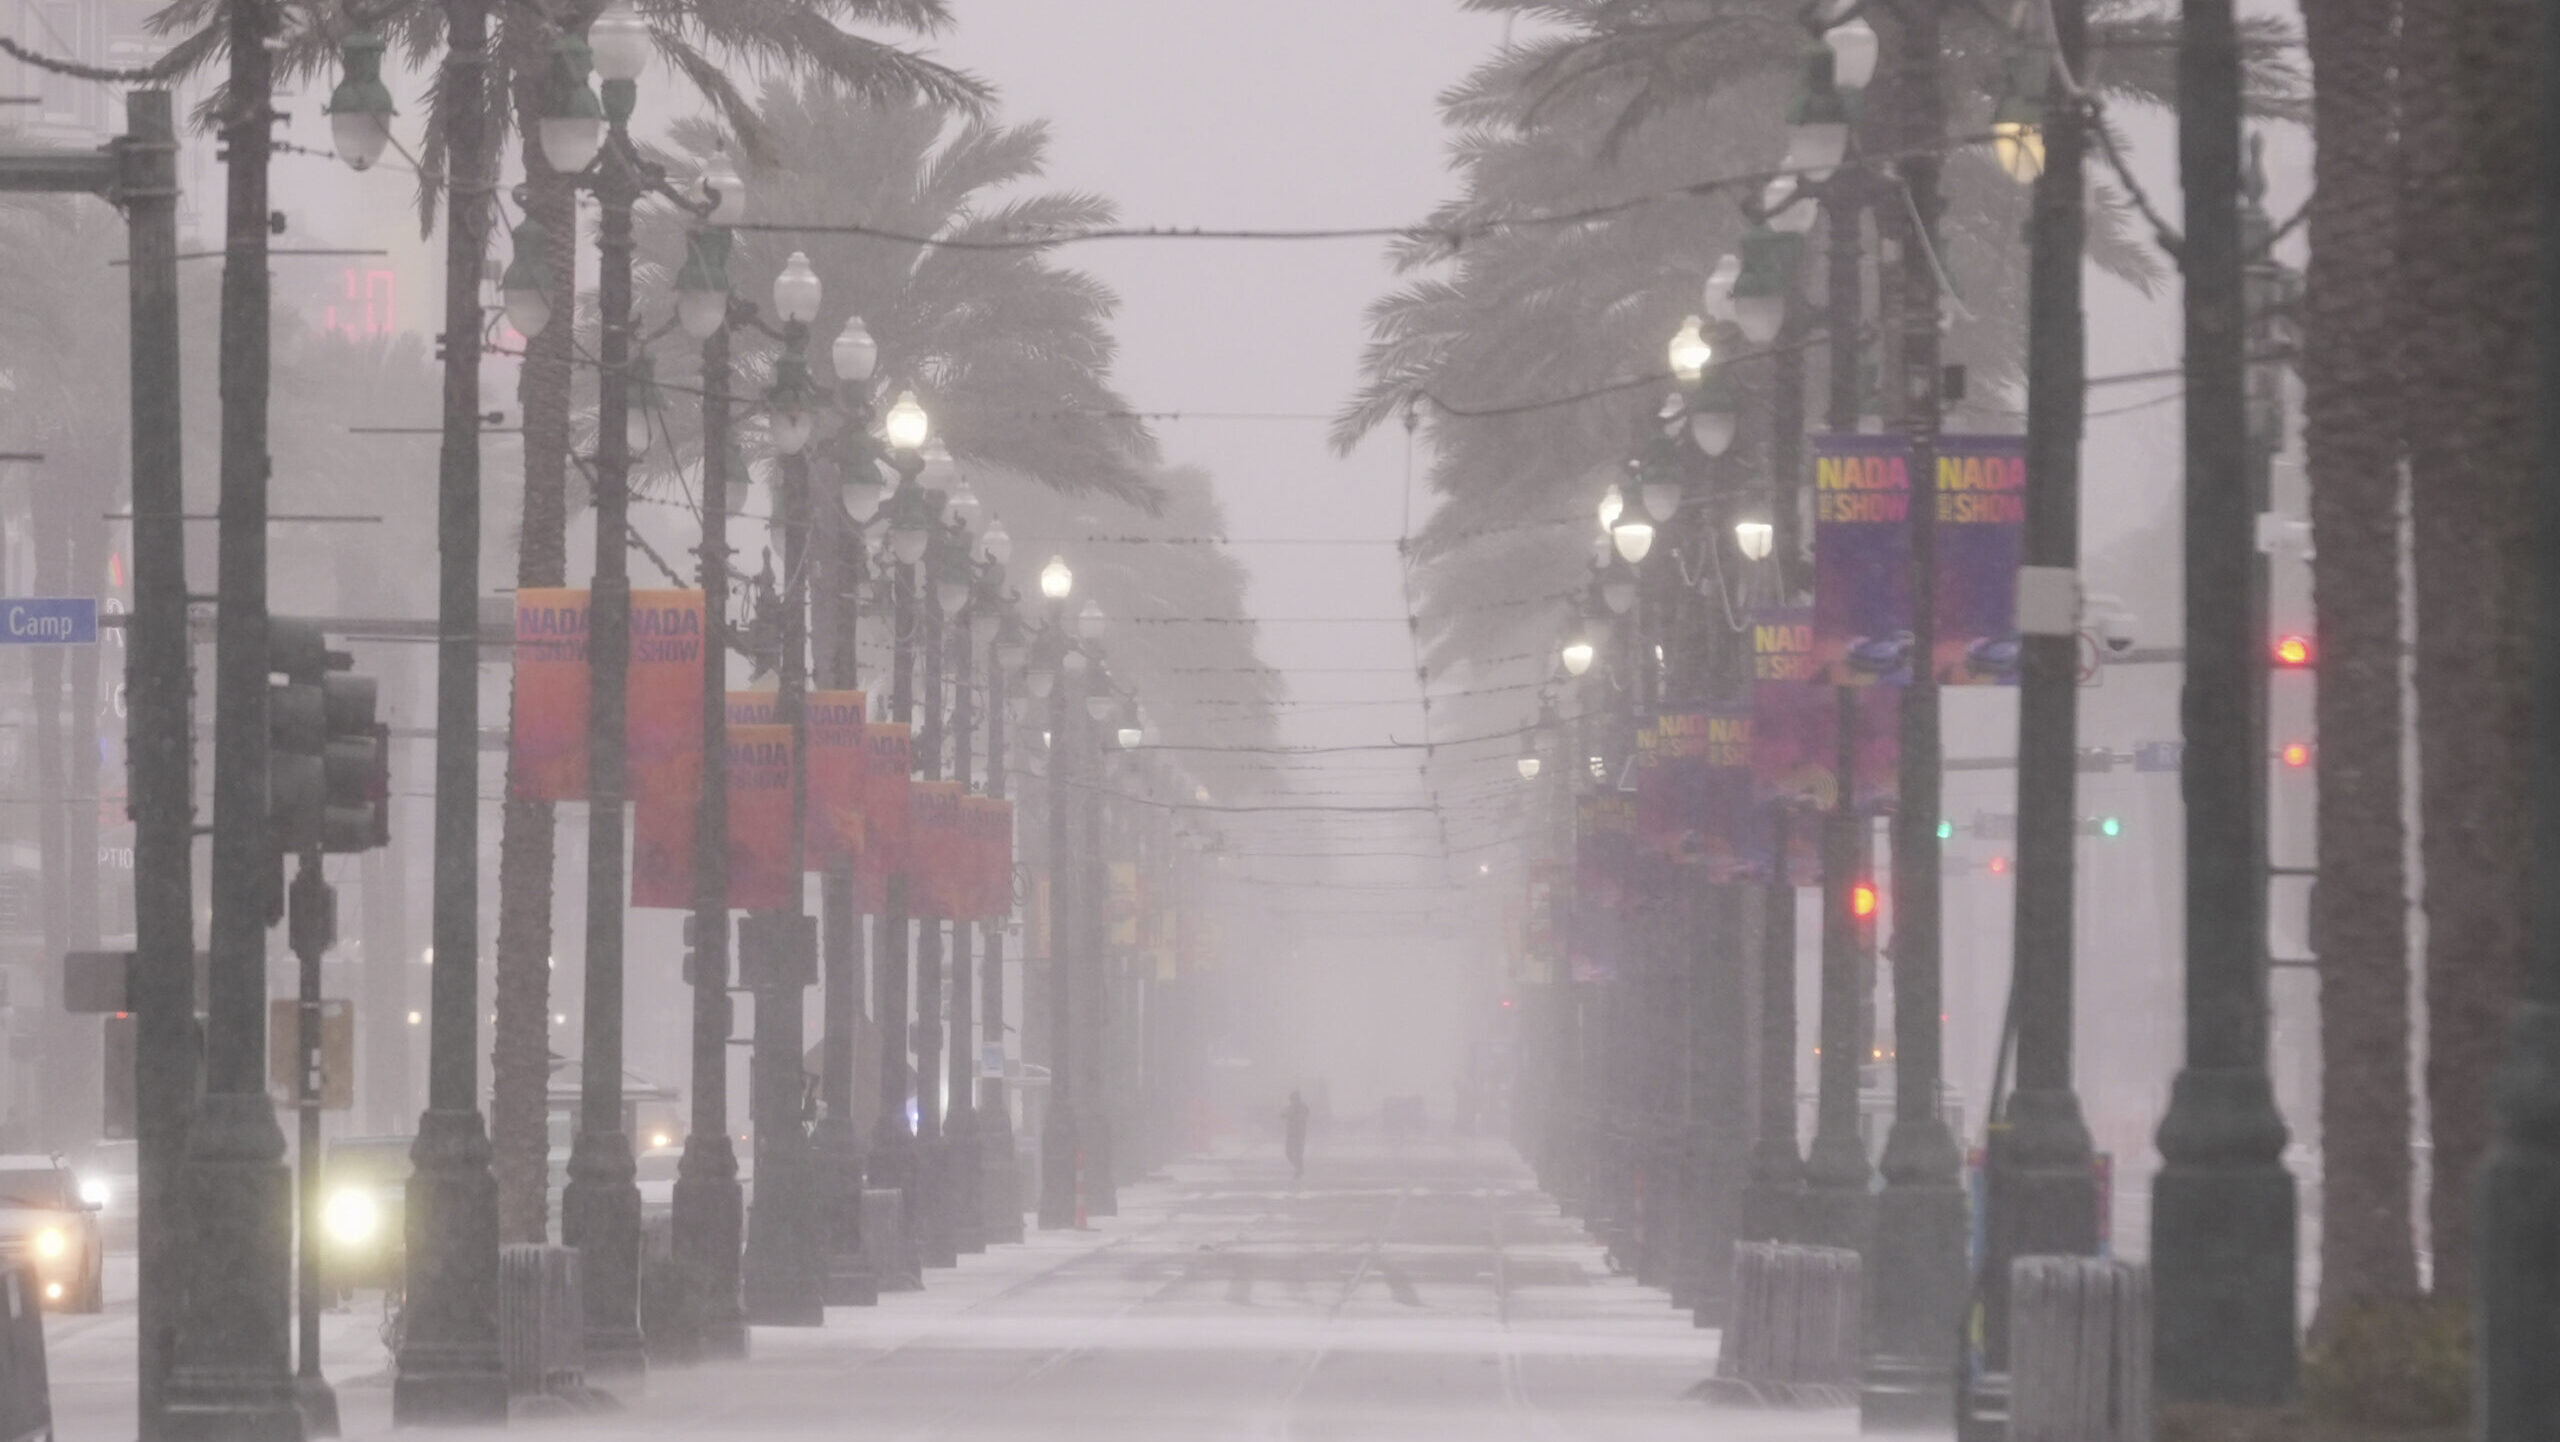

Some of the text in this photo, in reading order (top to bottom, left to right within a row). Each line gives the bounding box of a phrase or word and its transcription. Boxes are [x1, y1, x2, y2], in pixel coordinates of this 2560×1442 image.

[1817, 457, 1909, 490] NADA
[1936, 457, 2025, 491] NADA
[1836, 493, 1909, 523] SHOW
[1955, 493, 2025, 523] SHOW
[9, 607, 73, 640] Camp
[519, 607, 590, 634] NADA
[630, 607, 699, 636] NADA
[639, 639, 699, 663] SHOW
[1754, 624, 1813, 653] NAD
[1659, 714, 1705, 736] NAD
[1709, 719, 1752, 742] NA
[869, 735, 907, 755] ADA
